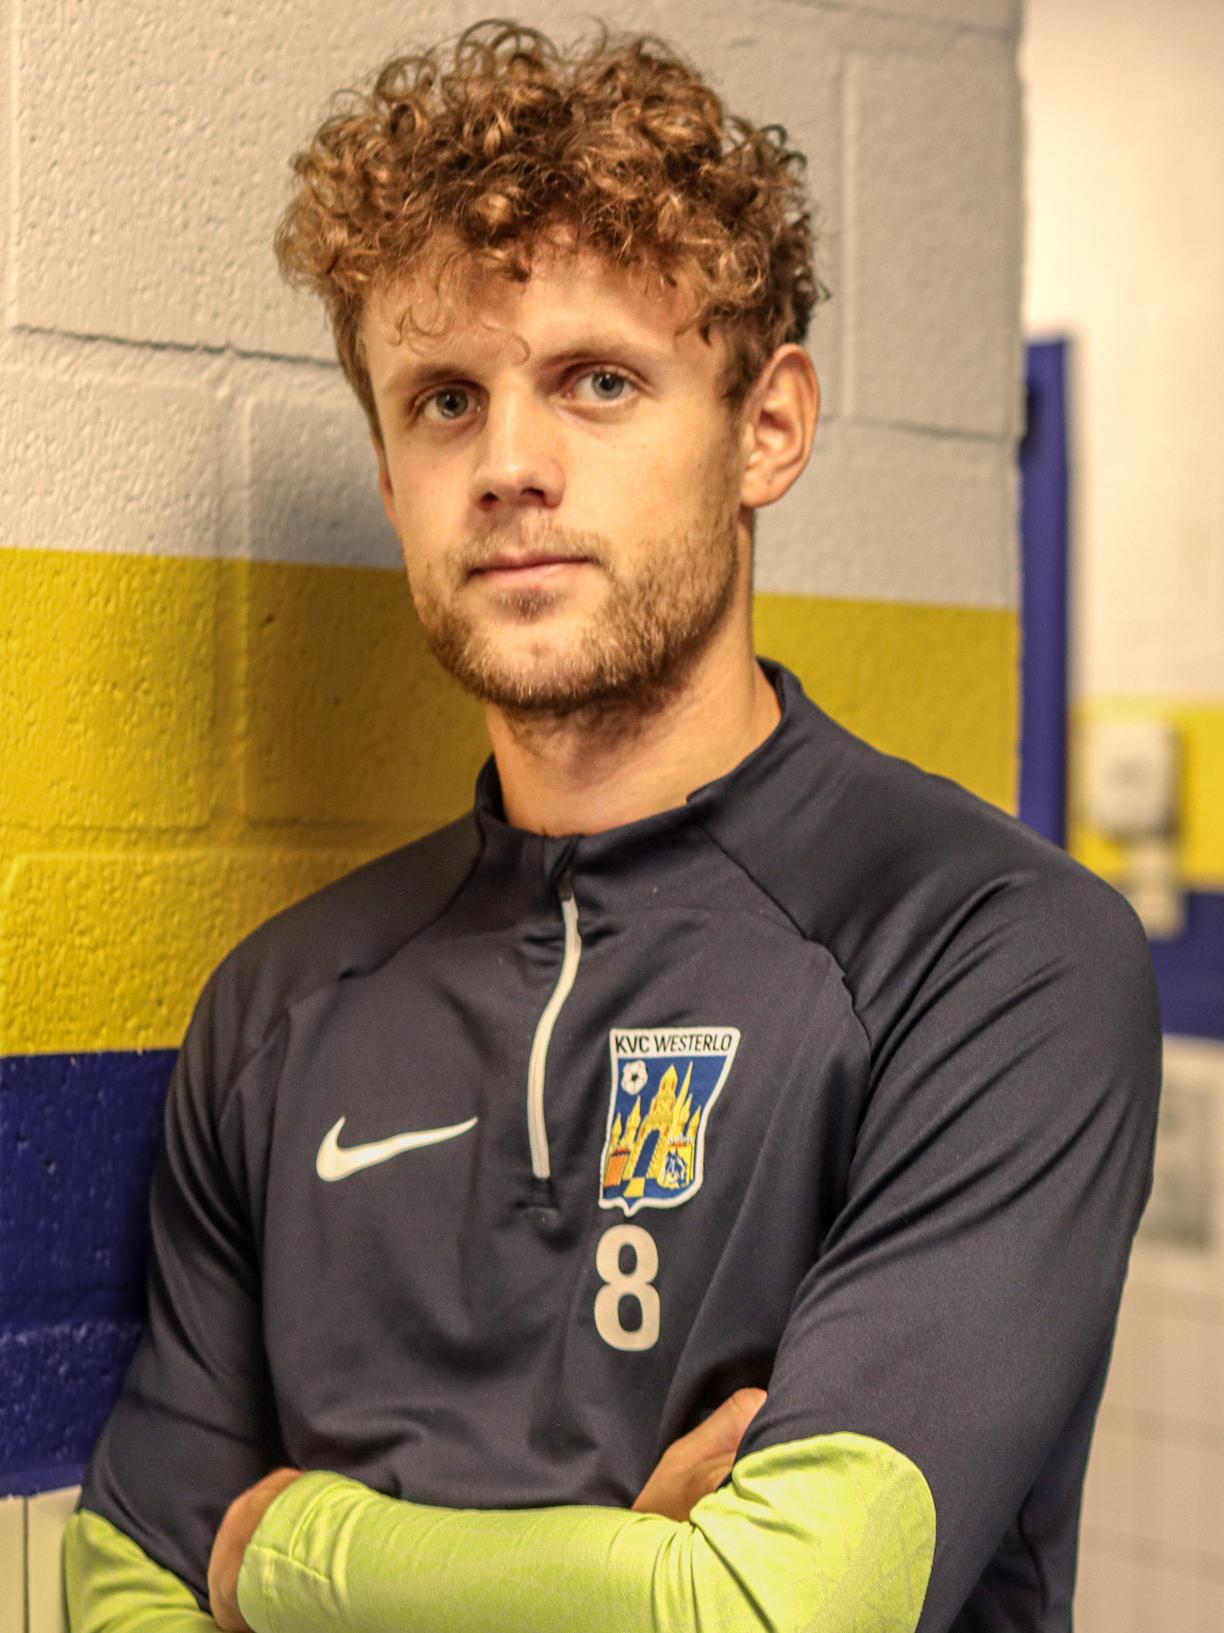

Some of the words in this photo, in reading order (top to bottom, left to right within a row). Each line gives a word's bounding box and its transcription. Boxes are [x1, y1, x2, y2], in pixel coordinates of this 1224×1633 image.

[614, 1035, 650, 1054] KVC
[654, 1033, 733, 1053] WESTERLO
[594, 1223, 660, 1351] 8
